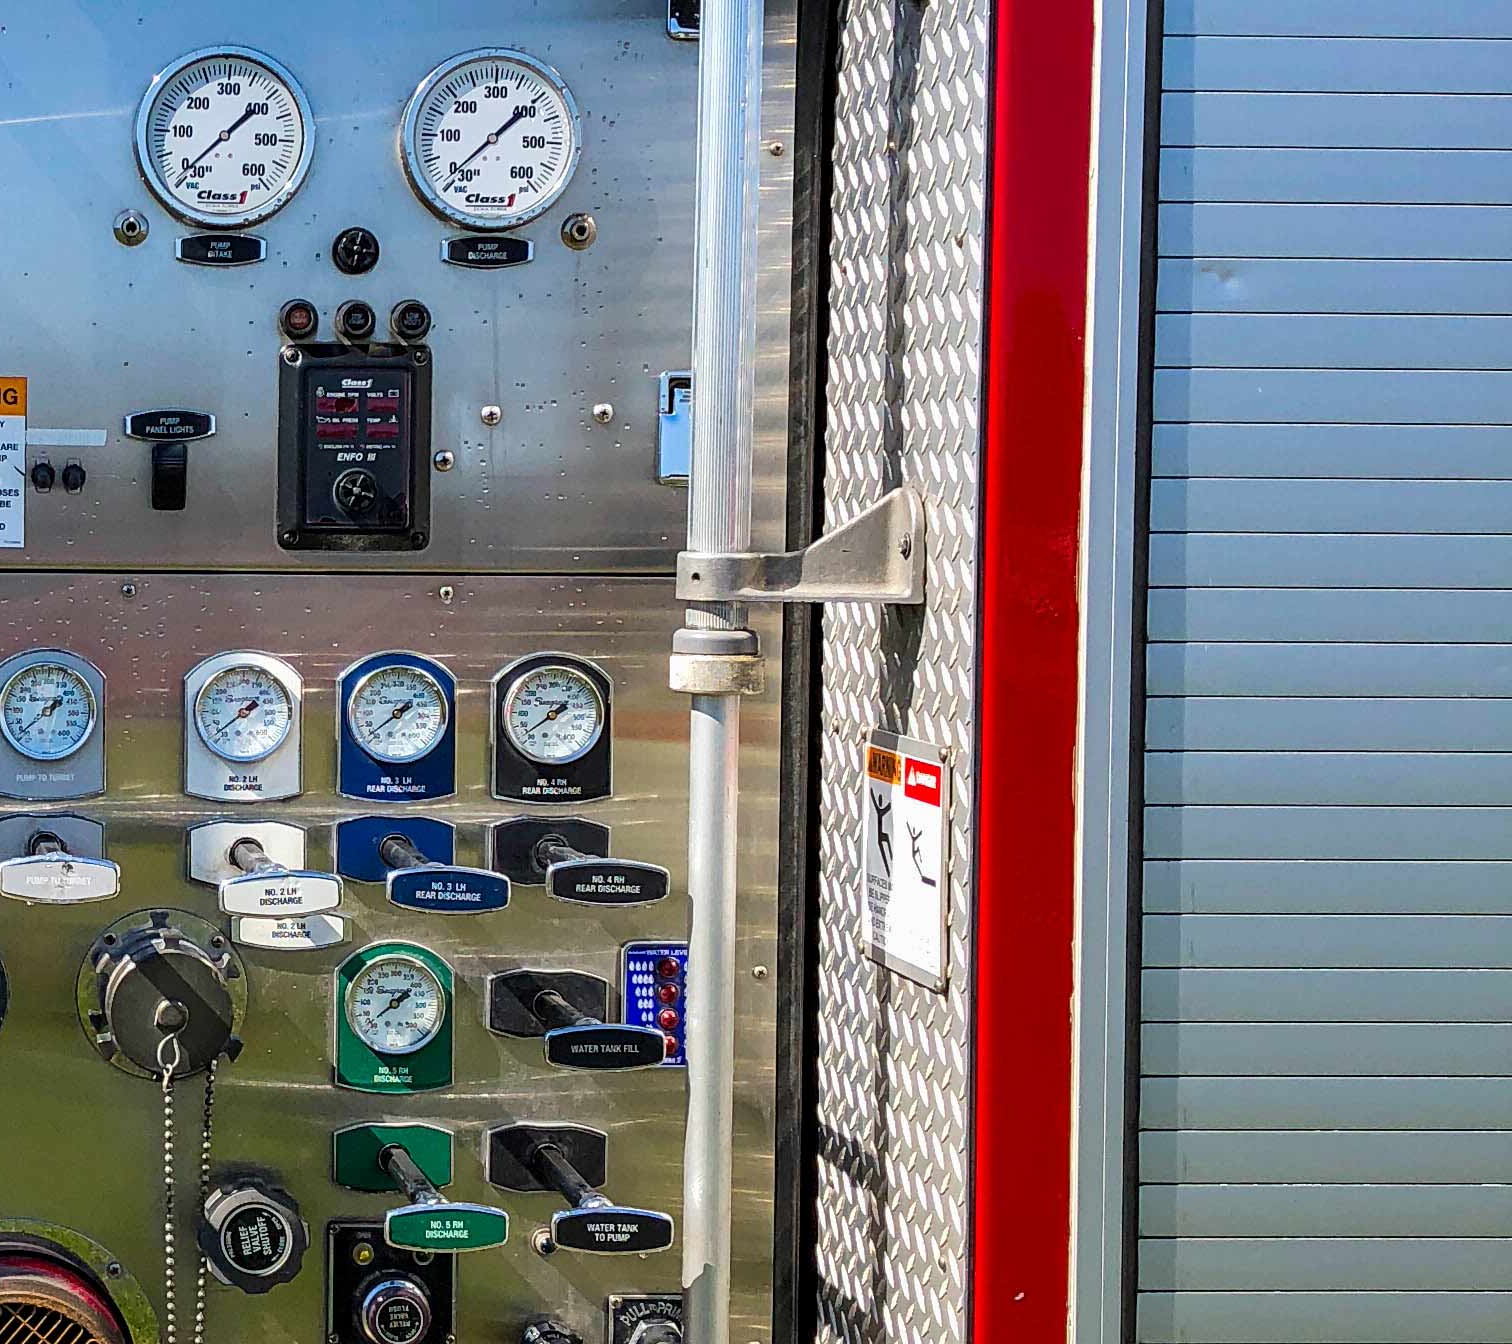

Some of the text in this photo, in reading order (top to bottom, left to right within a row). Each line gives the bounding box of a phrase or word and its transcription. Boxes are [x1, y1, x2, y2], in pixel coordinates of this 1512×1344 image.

[217, 83, 240, 95] 300
[484, 86, 507, 98] 300
[187, 97, 210, 110] 200
[246, 103, 268, 115] 400
[454, 101, 477, 114] 200
[513, 106, 536, 118] 400
[172, 125, 192, 137] 100
[439, 129, 460, 142] 100
[255, 134, 277, 146] 500
[522, 136, 545, 148] 500
[242, 164, 265, 176] 600
[510, 166, 533, 179] 600
[454, 185, 467, 193] VAC
[160, 417, 180, 425] PUMP
[145, 425, 194, 434] PANEL LIGHTS
[337, 453, 363, 461] ENFO
[592, 875, 625, 884] NO. 4 RH
[431, 882, 466, 891] NO. 3 LH
[576, 884, 640, 894] REAR DISCHARGE
[260, 897, 303, 906] DISCHARGE
[416, 890, 481, 902] REAR DISCHARGE
[571, 1044, 639, 1054] WATER TANK FILL
[431, 1221, 443, 1229] NO.
[446, 1221, 451, 1229] 5
[587, 1223, 638, 1232] WATER TANK
[248, 1224, 261, 1253] VALVE
[257, 1216, 272, 1256] SHUTOFF
[426, 1230, 469, 1239] DISCHARGE
[595, 1233, 630, 1242] TO PUMP
[239, 1226, 252, 1256] RELIEF
[620, 1302, 650, 1327] PULL
